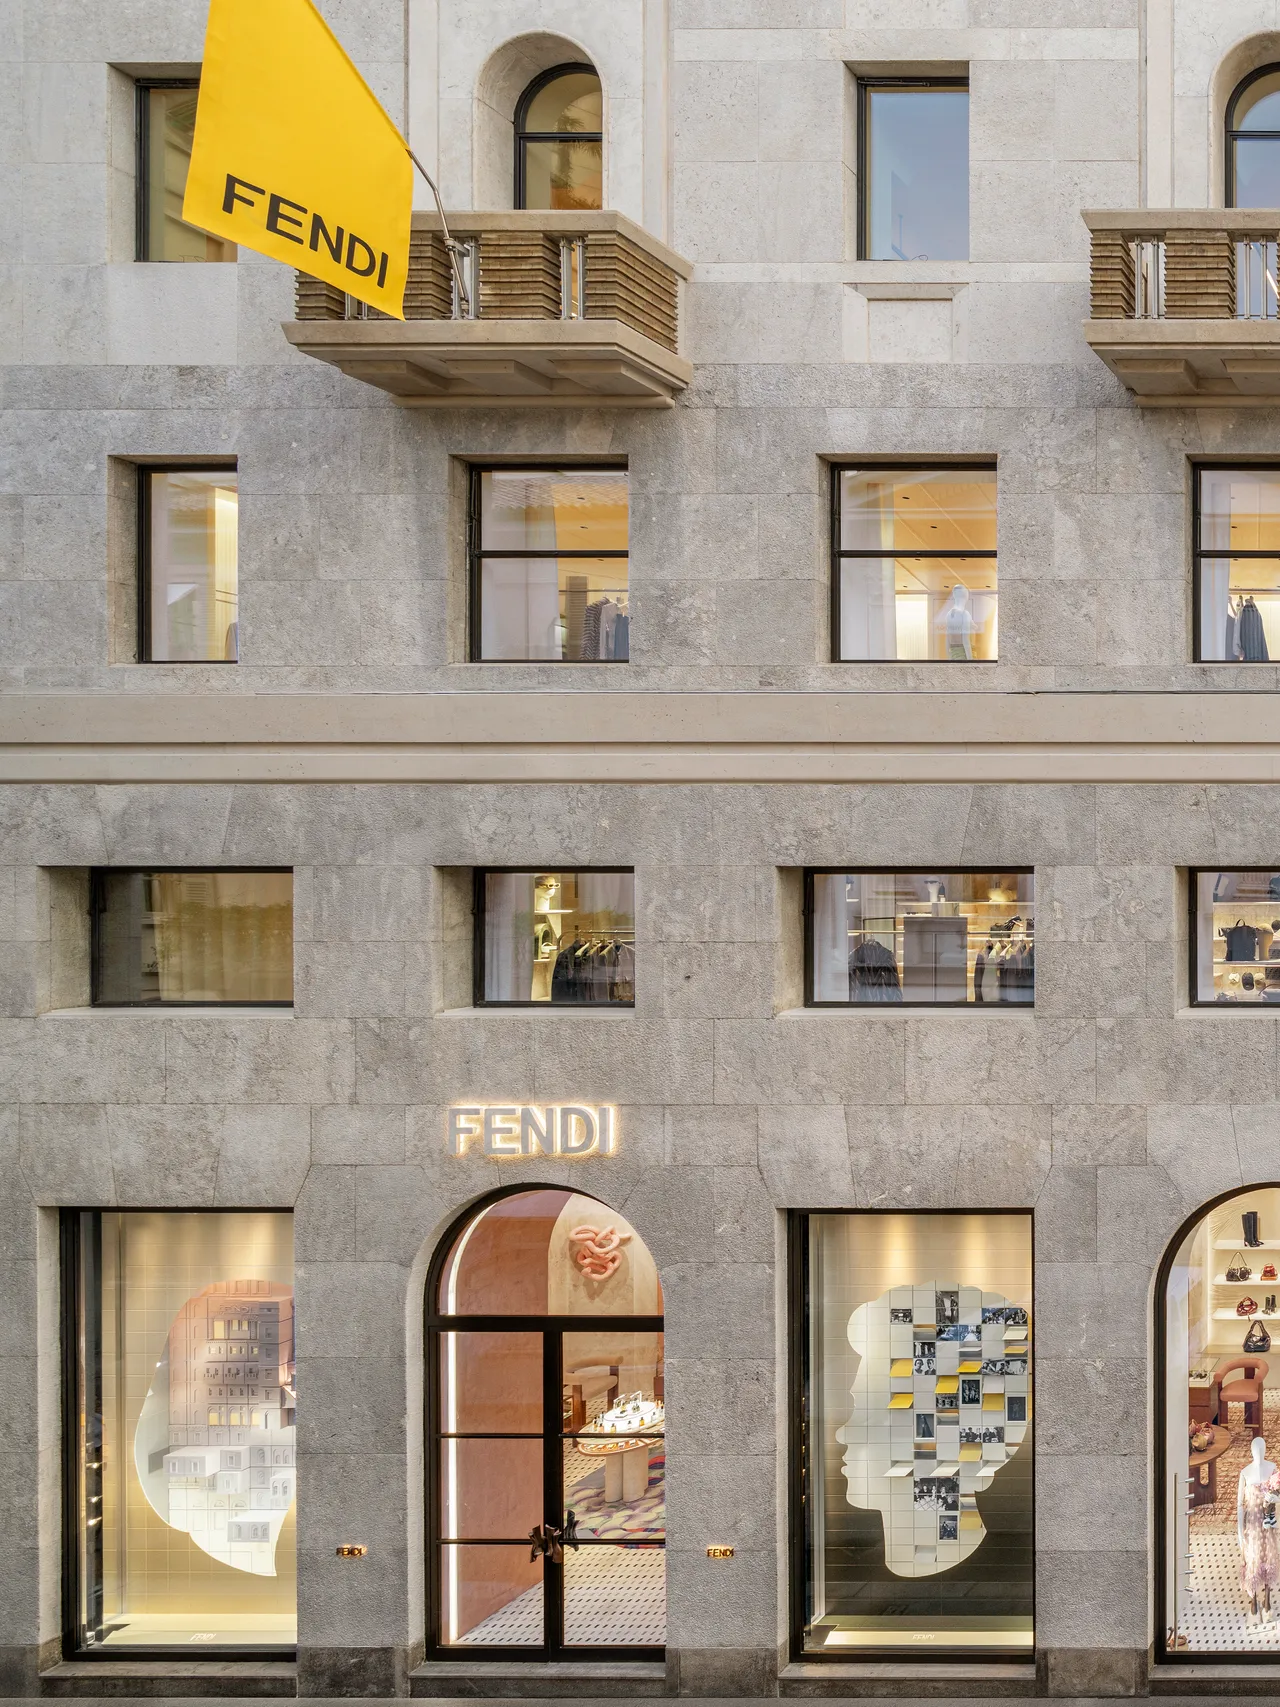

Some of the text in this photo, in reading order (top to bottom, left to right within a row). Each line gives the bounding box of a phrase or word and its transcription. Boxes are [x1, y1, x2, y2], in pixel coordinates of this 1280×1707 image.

[222, 173, 389, 289] FENDI
[448, 1106, 611, 1154] FENDI
[707, 1548, 735, 1557] FENDI
